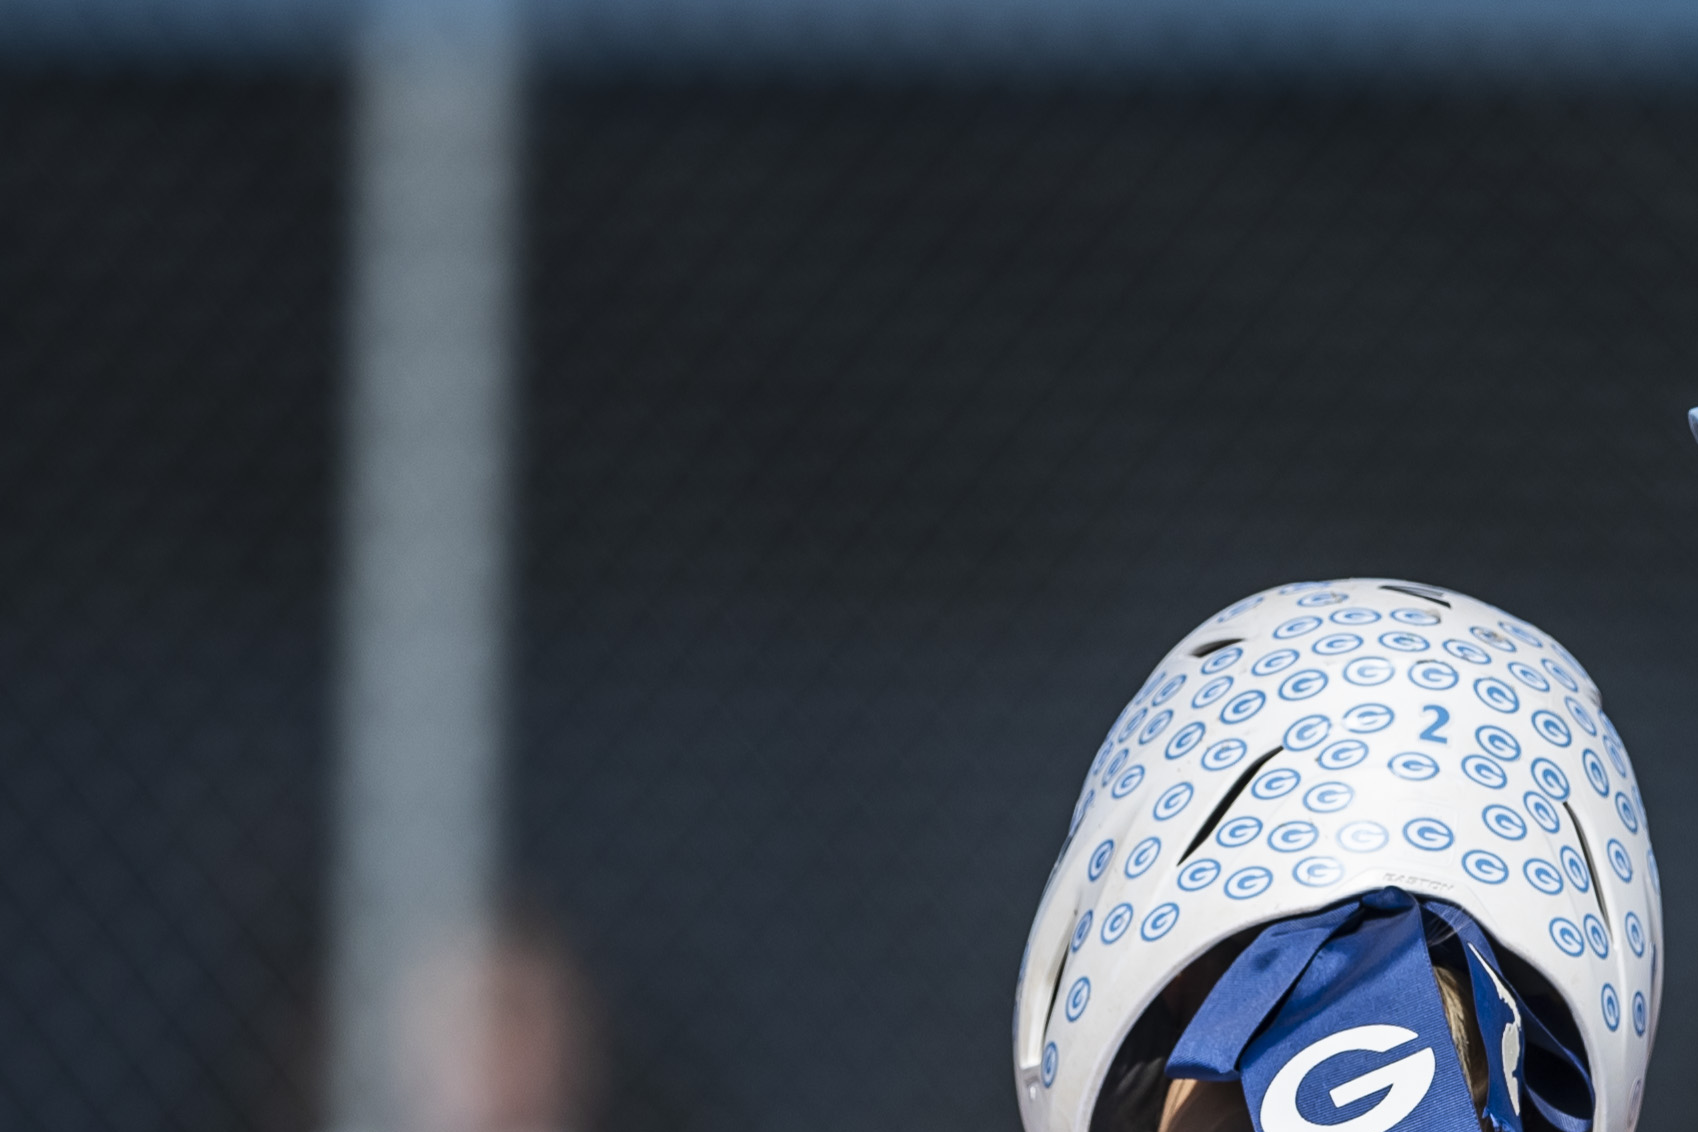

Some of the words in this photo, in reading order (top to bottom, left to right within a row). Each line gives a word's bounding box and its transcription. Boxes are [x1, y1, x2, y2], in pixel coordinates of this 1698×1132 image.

[1273, 617, 1323, 639] G
[1329, 609, 1382, 624] G
[1311, 634, 1363, 655] G
[1378, 632, 1430, 652] G
[1251, 649, 1299, 676] G
[1343, 657, 1395, 685] G
[1408, 661, 1459, 690] G
[1508, 662, 1550, 692] G
[1191, 676, 1234, 709] G
[1278, 669, 1328, 701] G
[1473, 677, 1519, 713] G
[1220, 690, 1266, 724] G
[1344, 703, 1394, 733] G
[1165, 721, 1205, 760] G
[1282, 715, 1332, 751] G
[1419, 704, 1450, 744] 2
[1532, 710, 1572, 747] G
[1201, 738, 1247, 771] G
[1318, 740, 1369, 770] G
[1475, 725, 1521, 761] G
[1388, 753, 1439, 780] G
[1461, 755, 1507, 789] G
[1531, 757, 1570, 801] G
[1251, 769, 1301, 799] G
[1303, 782, 1353, 812] G
[1153, 782, 1194, 821] G
[1524, 791, 1560, 834] G
[1216, 817, 1263, 847] G
[1268, 821, 1318, 852] G
[1403, 818, 1454, 851] G
[1482, 805, 1527, 840] G
[1124, 837, 1161, 879] G
[1462, 850, 1508, 884] G
[1560, 846, 1591, 893] G
[1177, 859, 1221, 891] G
[1224, 866, 1273, 899] G
[1523, 858, 1563, 895] G
[1101, 902, 1133, 945] G
[1141, 902, 1179, 941] G
[1549, 917, 1585, 957] G
